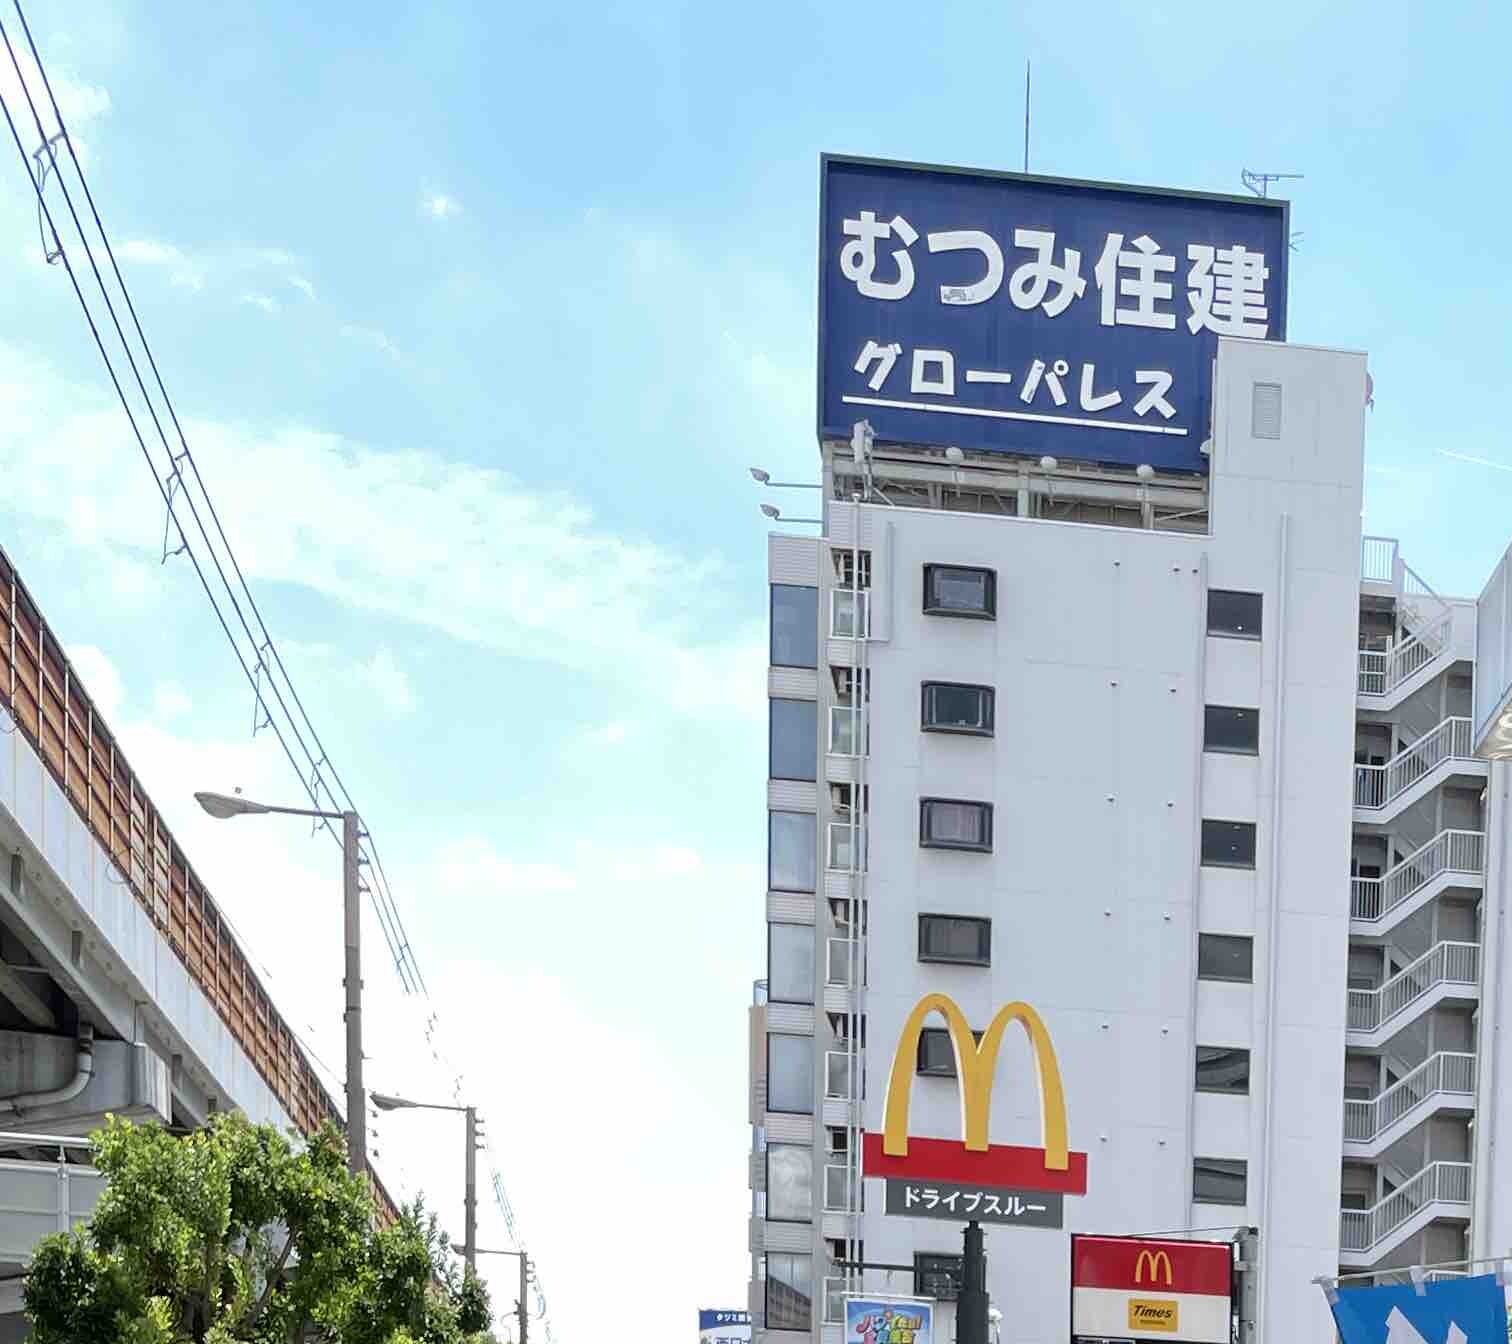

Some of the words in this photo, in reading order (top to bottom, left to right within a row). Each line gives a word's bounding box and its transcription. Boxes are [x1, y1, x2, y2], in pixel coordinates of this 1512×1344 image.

[839, 210, 1271, 340] むつみ住建
[853, 339, 1177, 420] グローパレス
[904, 1185, 1047, 1217] ドライブスルー
[1133, 1304, 1173, 1319] Times
